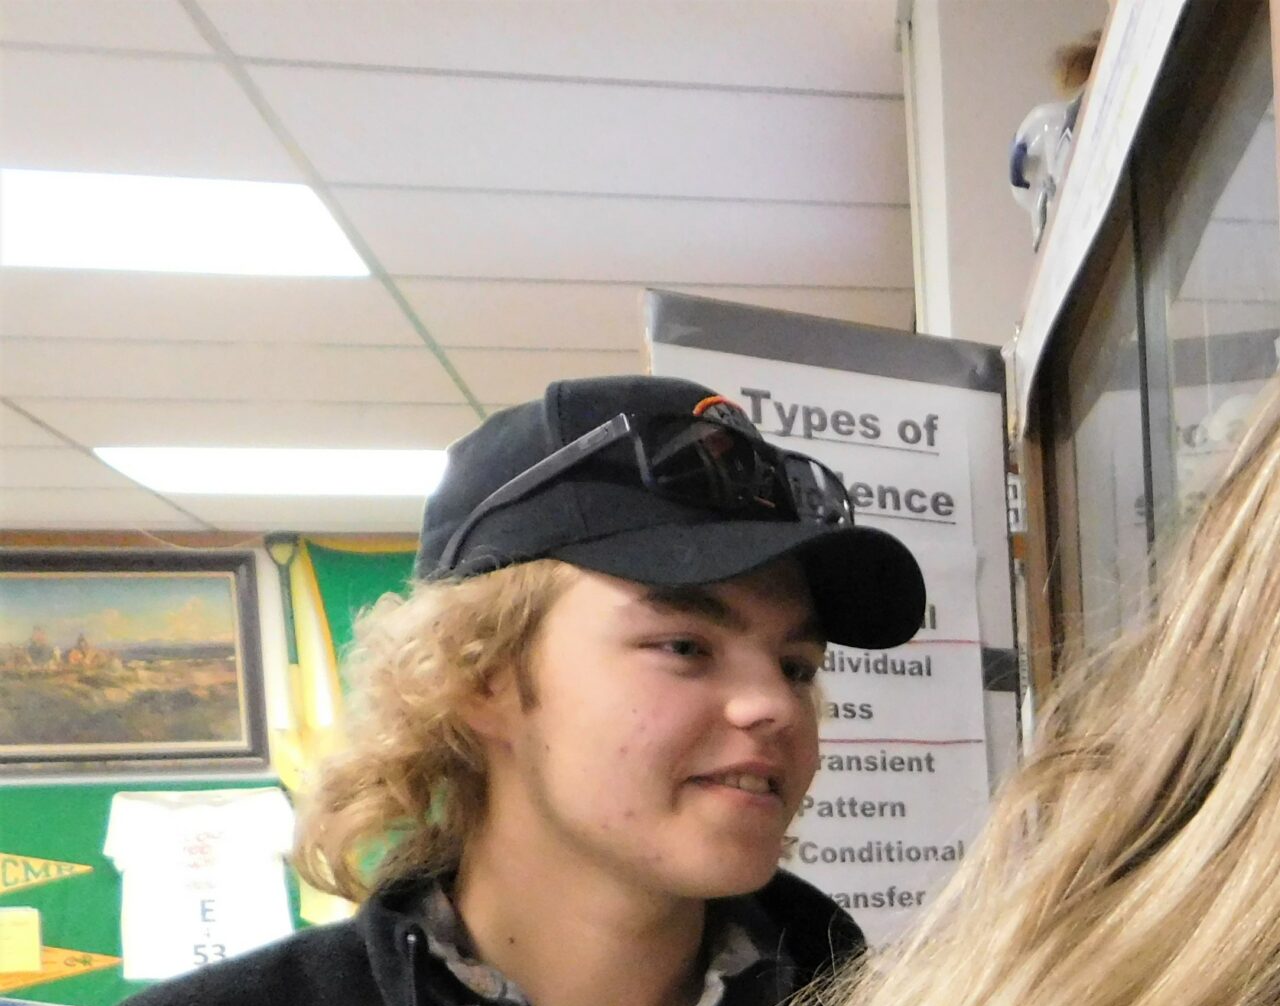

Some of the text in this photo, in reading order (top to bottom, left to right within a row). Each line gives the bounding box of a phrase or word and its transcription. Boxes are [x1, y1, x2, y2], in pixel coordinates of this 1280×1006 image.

[740, 387, 939, 446] Types of
[822, 650, 932, 677] dividual
[826, 701, 874, 720] ass
[818, 750, 936, 773] ransient
[798, 795, 906, 818] Pattern
[799, 840, 965, 864] Conditional
[831, 886, 927, 908] ansfer
